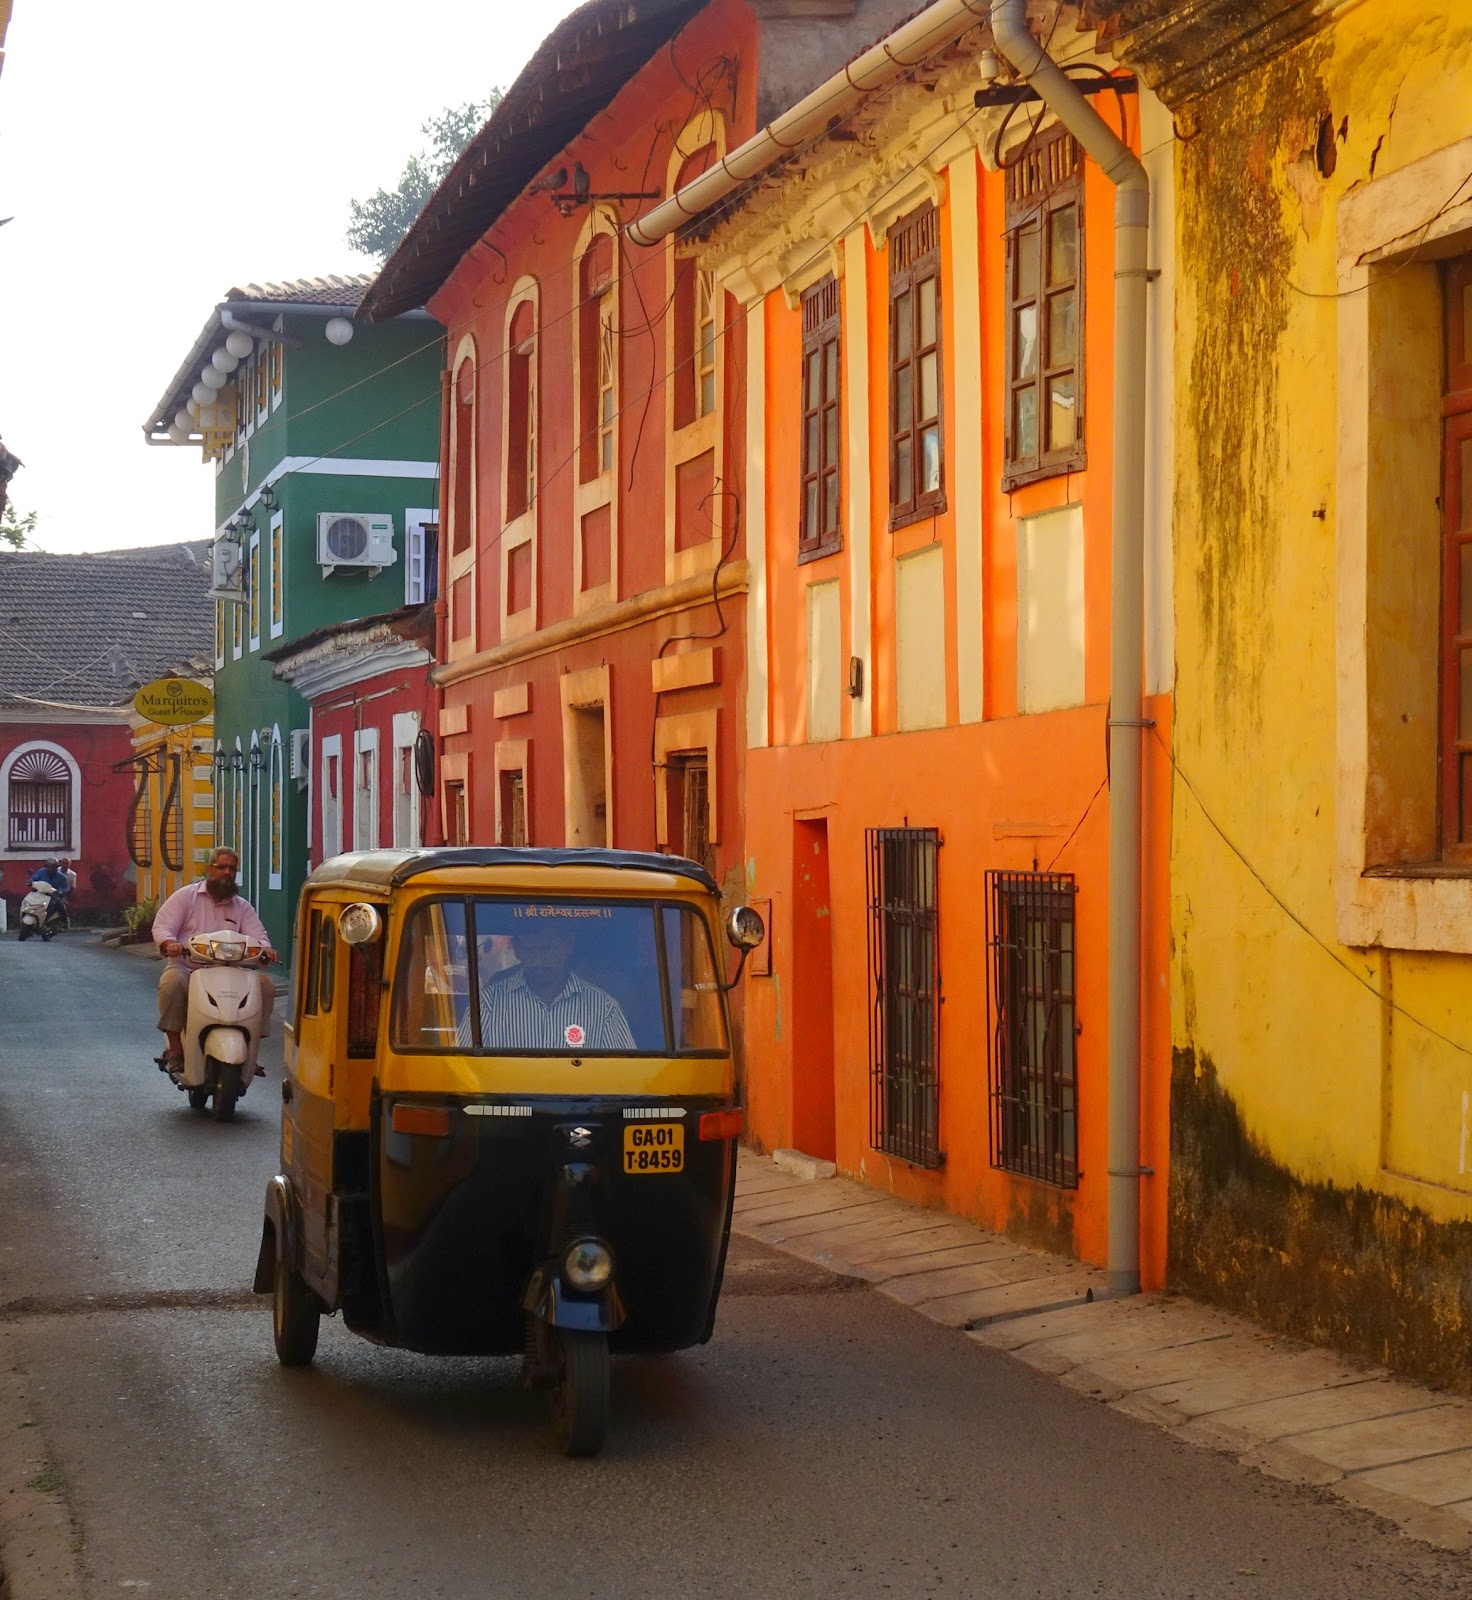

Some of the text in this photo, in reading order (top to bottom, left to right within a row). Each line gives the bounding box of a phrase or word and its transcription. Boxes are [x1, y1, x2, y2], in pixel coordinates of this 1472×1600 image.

[142, 694, 208, 715] Marquito's
[148, 708, 205, 716] Guest House
